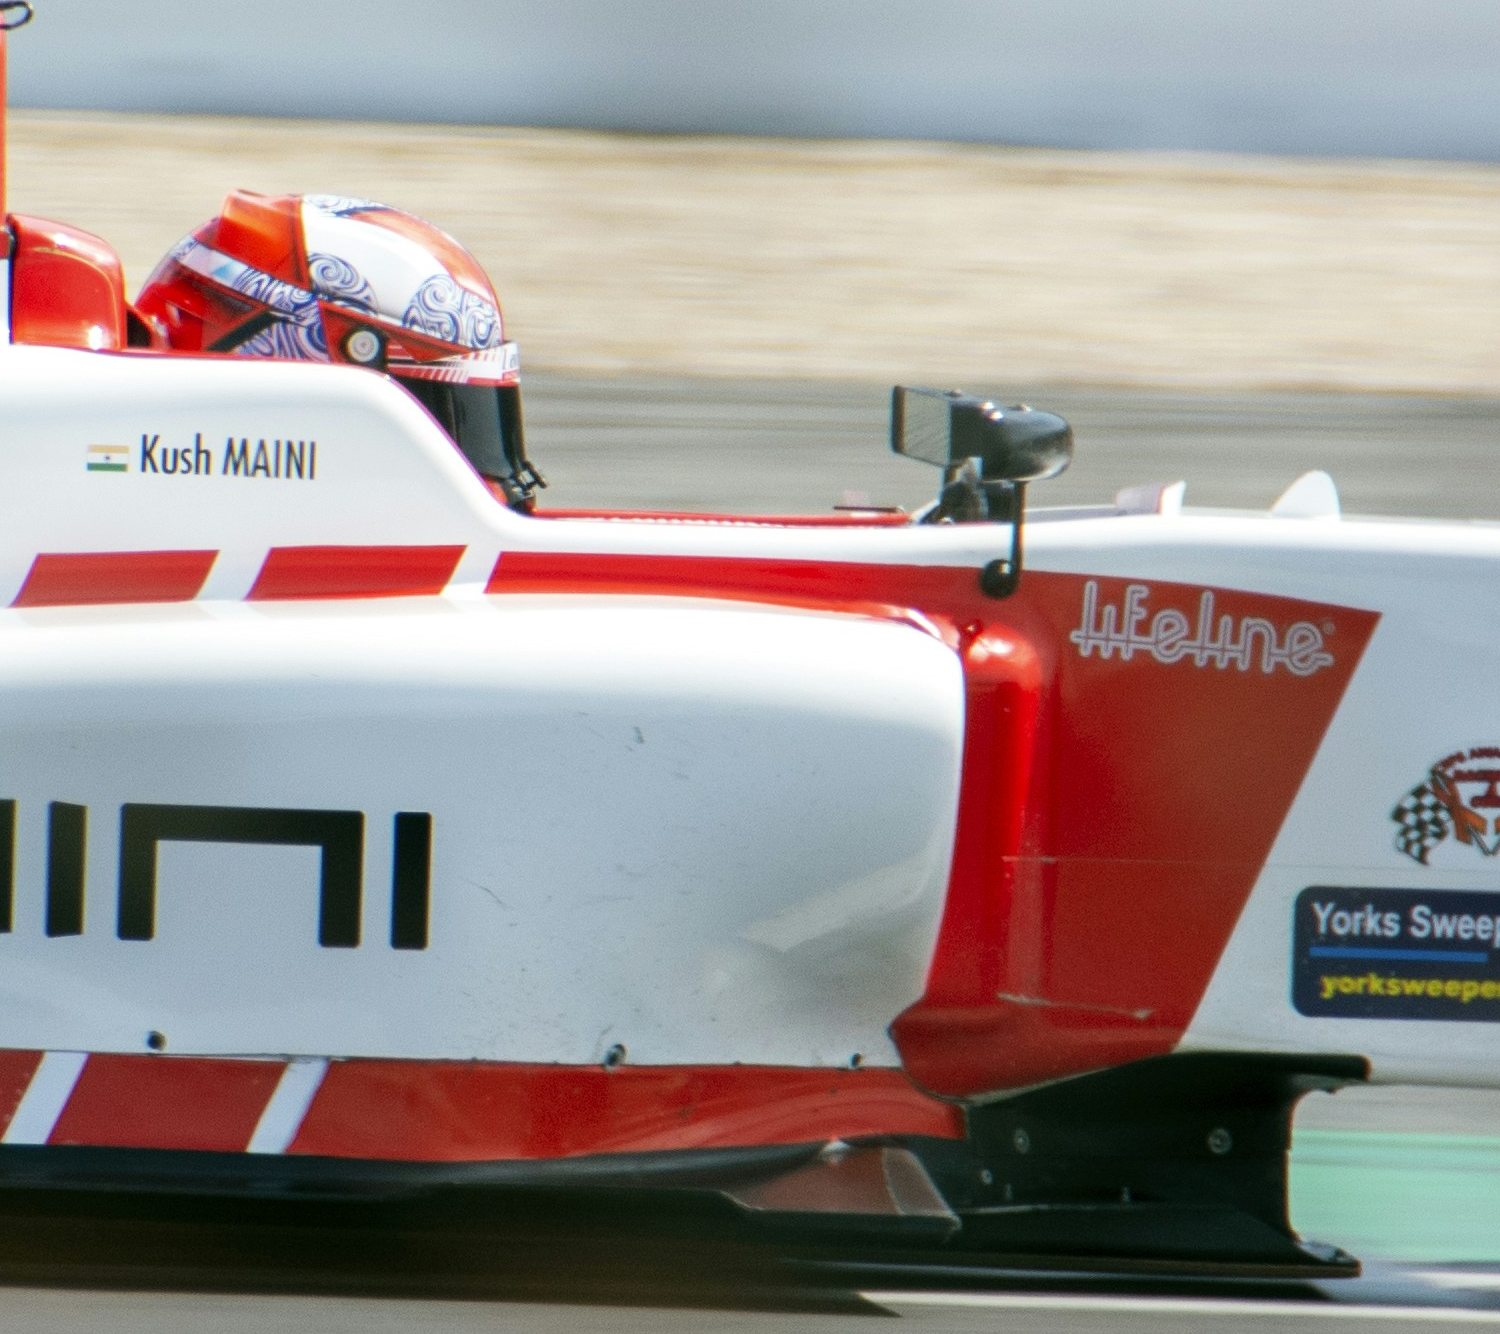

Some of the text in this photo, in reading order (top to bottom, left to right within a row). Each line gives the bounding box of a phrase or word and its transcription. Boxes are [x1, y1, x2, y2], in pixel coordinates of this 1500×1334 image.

[140, 432, 318, 481] Kush MAINI
[1313, 901, 1401, 938] Yorks
